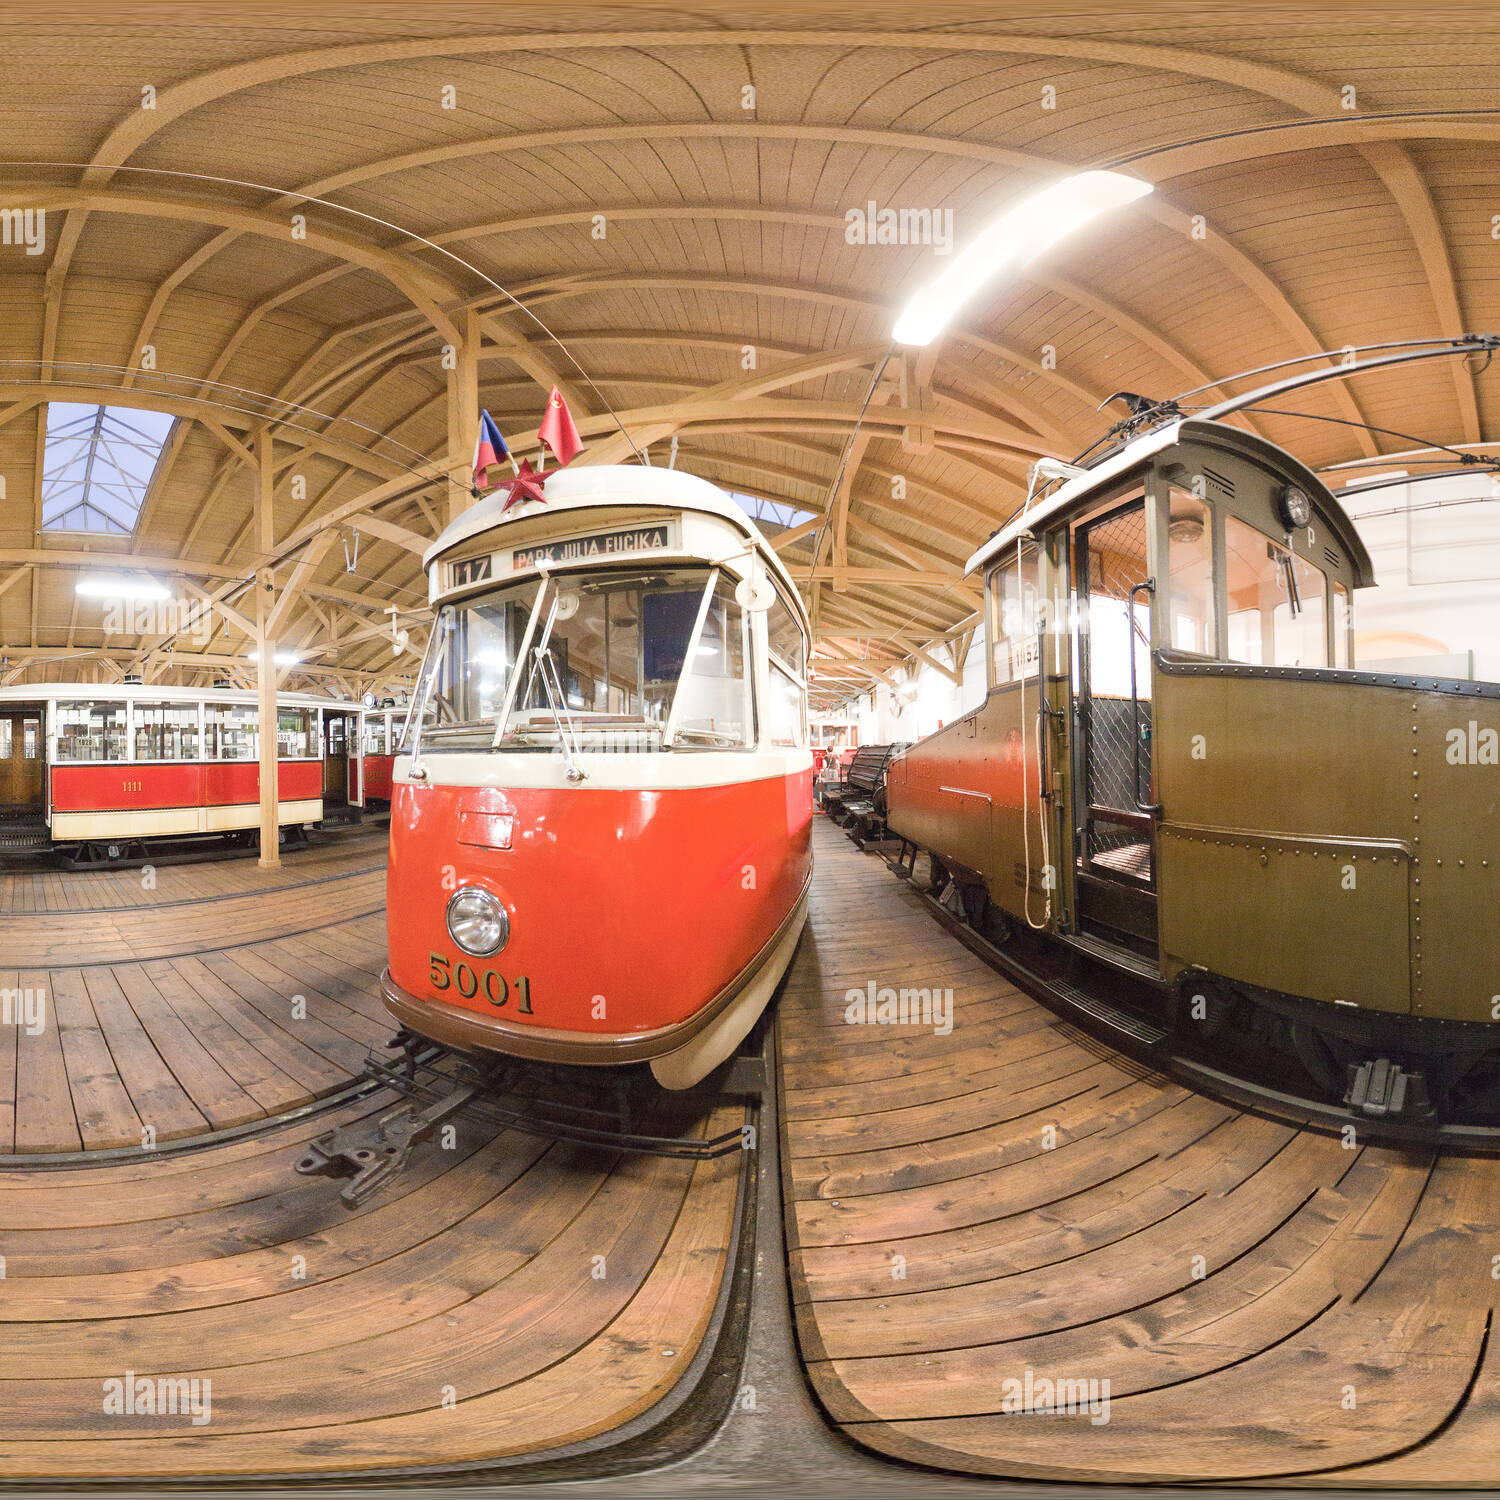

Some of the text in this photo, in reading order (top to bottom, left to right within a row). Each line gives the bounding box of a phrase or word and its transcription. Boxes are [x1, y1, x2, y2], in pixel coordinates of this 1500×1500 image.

[1307, 526, 1315, 548] P
[518, 547, 555, 568] PARK
[560, 539, 599, 560] JULIA
[463, 557, 489, 584] 17
[123, 781, 142, 792] 1111
[429, 951, 534, 1016] 5001
